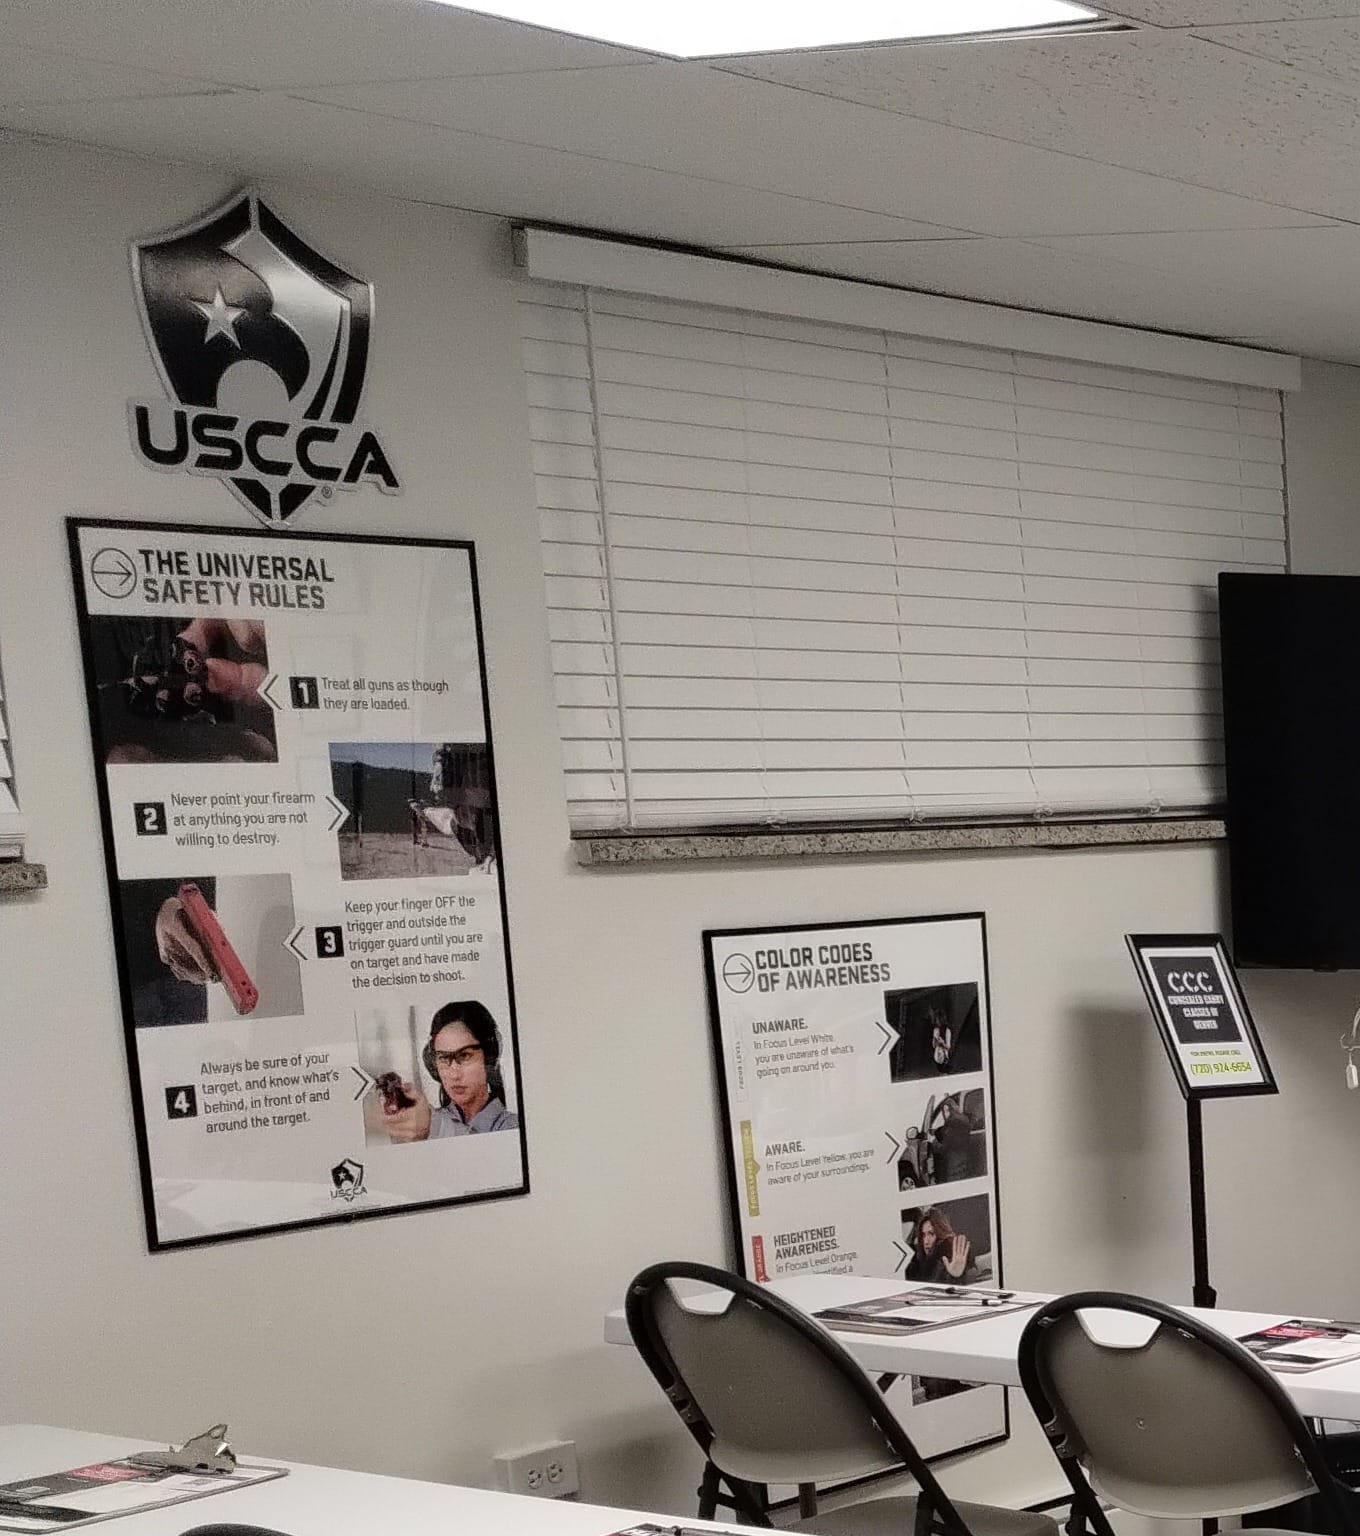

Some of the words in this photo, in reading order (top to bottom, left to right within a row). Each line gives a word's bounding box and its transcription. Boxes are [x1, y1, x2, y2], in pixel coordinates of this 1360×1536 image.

[135, 405, 399, 487] USCCA
[139, 550, 190, 575] THE
[197, 552, 334, 582] UNIVERSAL
[143, 579, 241, 605] SAFETY
[250, 583, 325, 610] RULES
[299, 682, 309, 704] 1
[321, 678, 350, 690] Treat
[353, 678, 365, 690] all
[368, 680, 394, 692] guns
[397, 681, 409, 690] as
[412, 680, 448, 694] though
[324, 697, 348, 712] they
[351, 700, 368, 709] are
[371, 698, 409, 710] loaded.
[171, 794, 207, 806] Never
[211, 793, 240, 807] point
[244, 794, 268, 807] your
[272, 792, 315, 804] firearm
[143, 808, 158, 831] 2
[174, 815, 186, 826] at
[190, 813, 241, 829] anything
[243, 814, 264, 827] you
[268, 814, 286, 823] are
[289, 812, 308, 823] not
[176, 833, 214, 848] willing
[218, 833, 229, 844] to
[233, 833, 279, 846] destroy.
[345, 901, 373, 914] Keep
[376, 900, 399, 915] your
[402, 899, 434, 912] finger
[436, 897, 455, 907] OFF
[459, 896, 475, 907] the
[347, 921, 383, 934] trigger
[386, 918, 405, 929] and
[408, 915, 447, 928] outside
[450, 915, 466, 925] the
[324, 932, 336, 953] 3
[349, 939, 385, 952] trigger
[388, 936, 418, 950] guard
[421, 933, 443, 946] until
[446, 935, 464, 947] you
[466, 933, 483, 942] are
[351, 959, 364, 969] on
[367, 956, 400, 970] target
[402, 954, 421, 965] and
[424, 953, 448, 964] have
[452, 950, 479, 962] made
[755, 947, 814, 970] COLOR
[819, 943, 873, 964] CODES
[352, 976, 369, 988] the
[373, 974, 417, 986] decision
[420, 973, 430, 983] to
[433, 970, 465, 982] shoot.
[758, 972, 780, 992] OF
[786, 963, 890, 990] AWARENESS
[1168, 971, 1213, 993] CCC
[753, 1018, 808, 1034] UNAWARE.
[201, 1063, 242, 1075] Always
[245, 1059, 259, 1071] be
[262, 1057, 288, 1069] sure
[290, 1054, 302, 1066] of
[305, 1054, 329, 1068] your
[245, 1078, 266, 1090] and
[270, 1076, 300, 1088] know
[174, 1090, 190, 1113] 4
[251, 1097, 261, 1108] in
[264, 1094, 292, 1108] front
[295, 1092, 307, 1103] of
[309, 1089, 330, 1102] and
[206, 1118, 248, 1133] around
[251, 1116, 269, 1127] the
[765, 1141, 806, 1156] AWARE.
[330, 1187, 367, 1198] USCCA
[774, 1226, 835, 1247] HEIGHTENED
[776, 1239, 840, 1260] AWARENESS.
